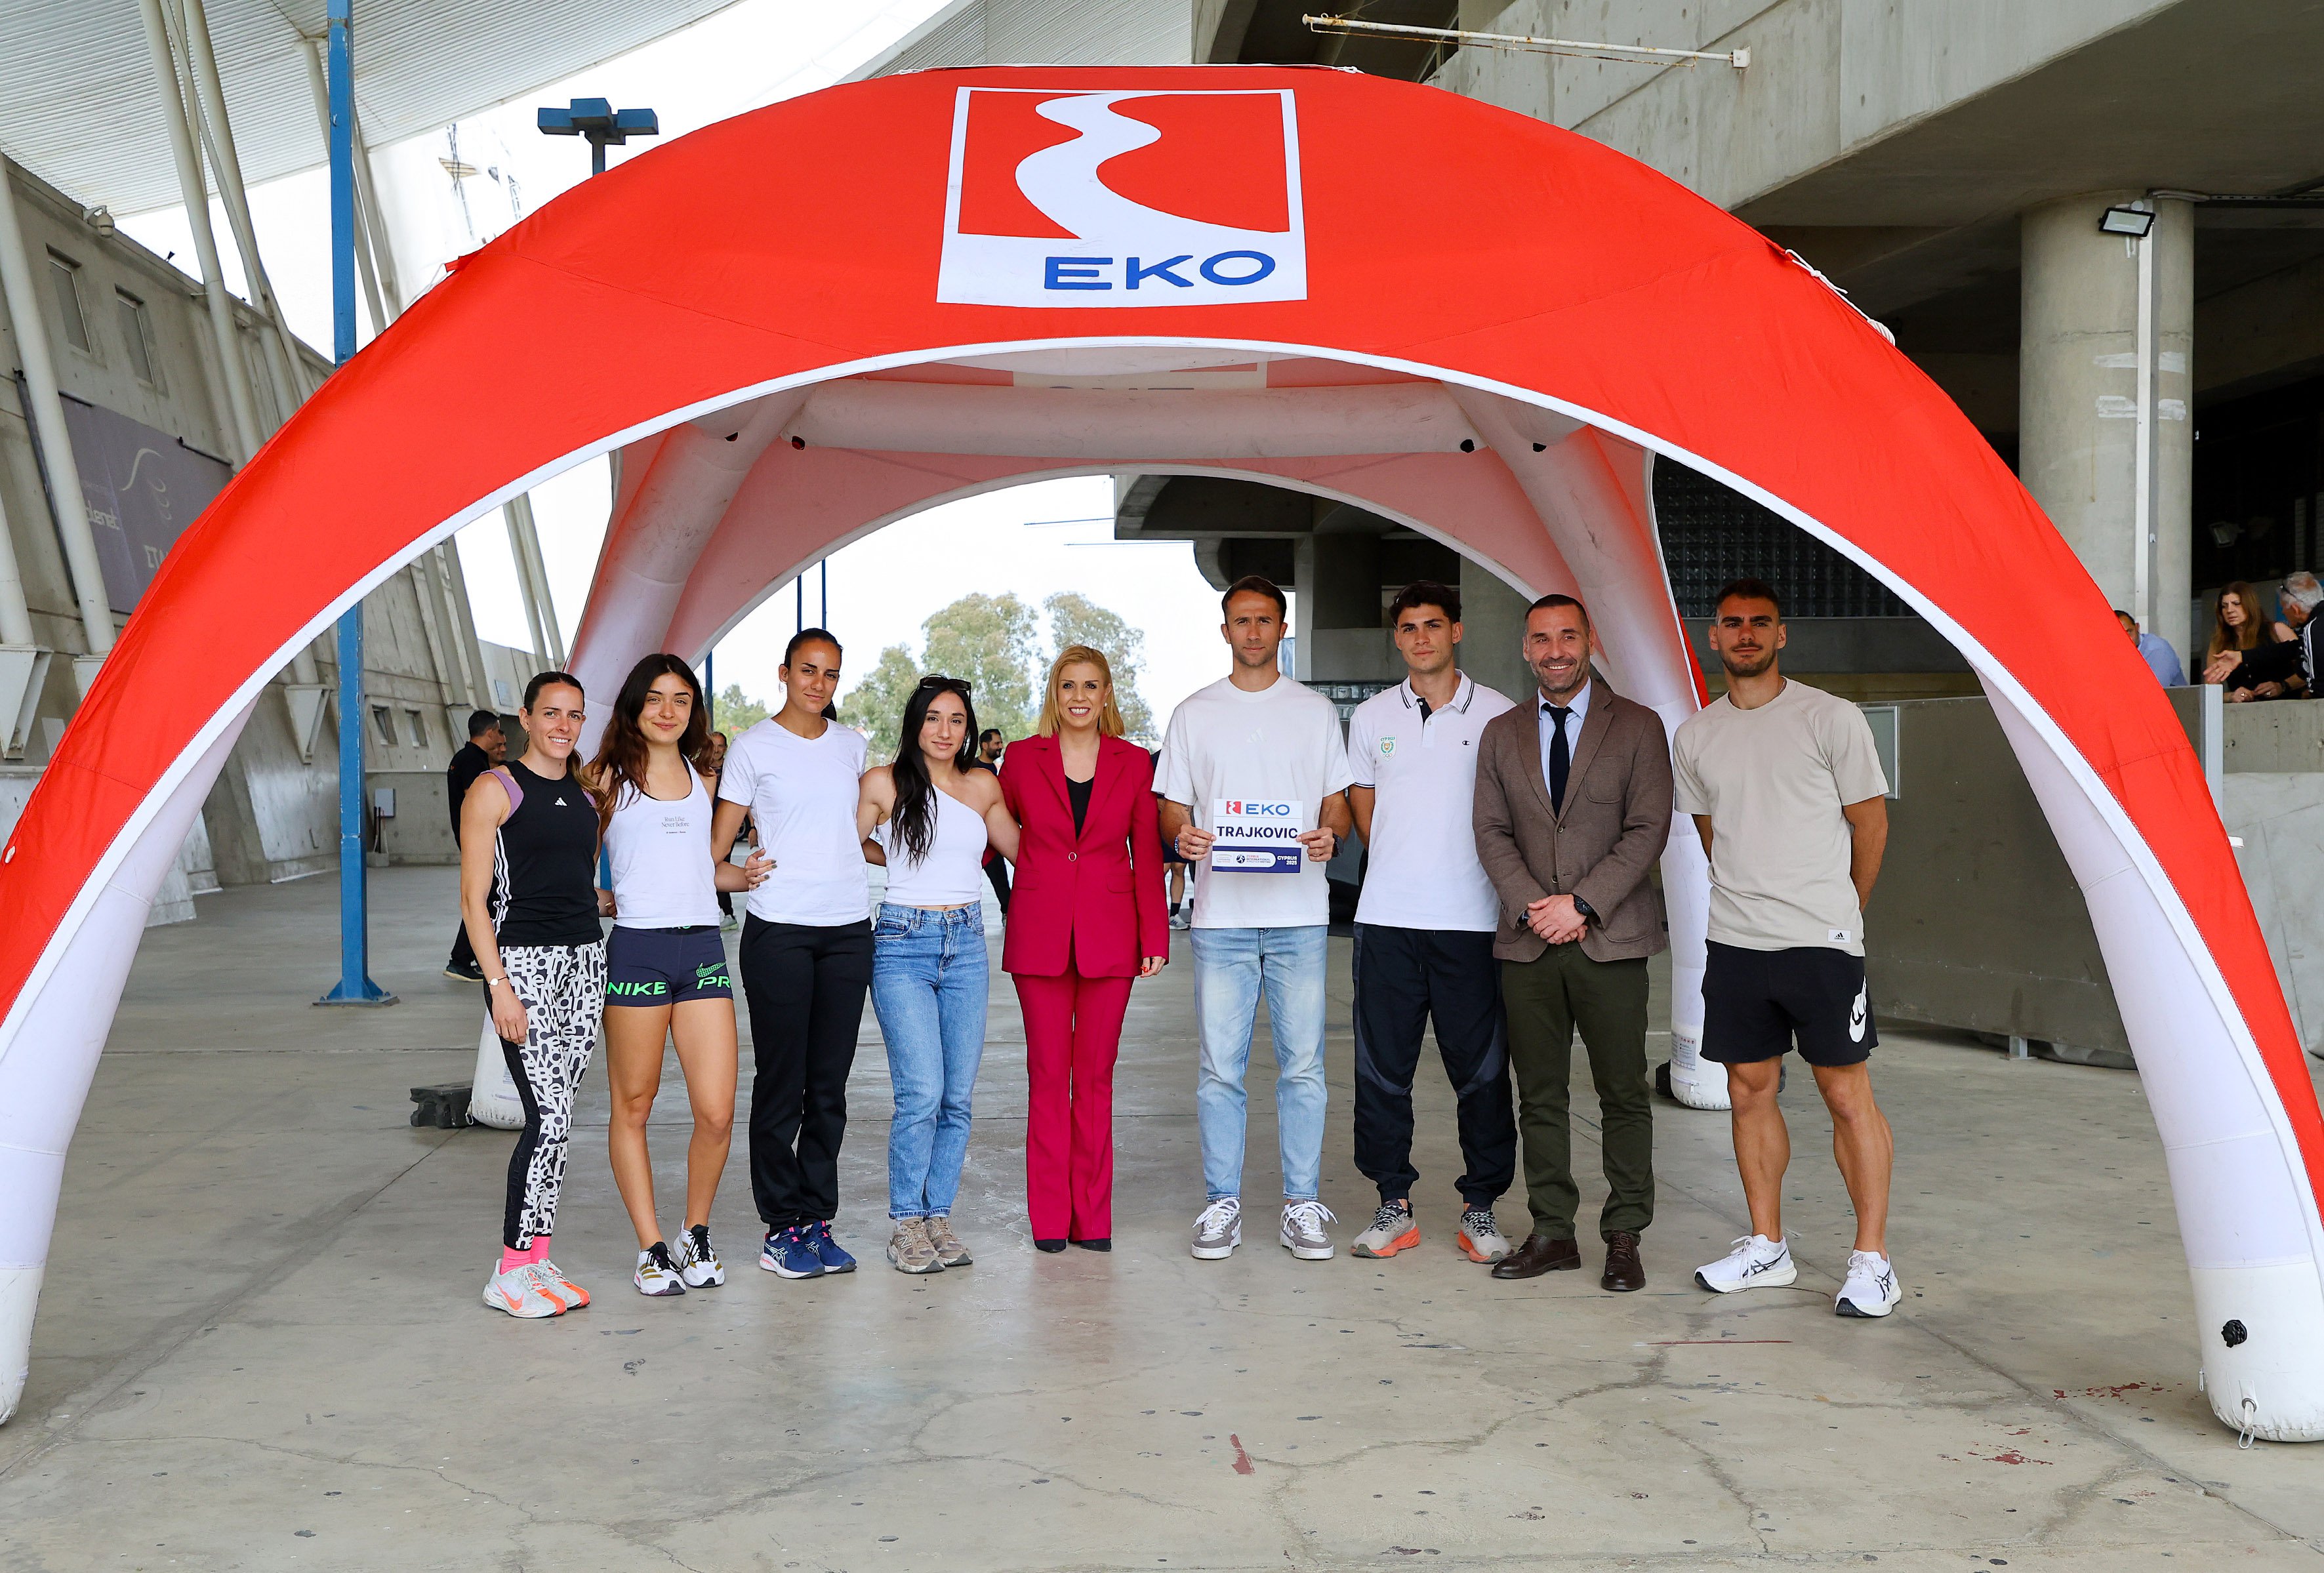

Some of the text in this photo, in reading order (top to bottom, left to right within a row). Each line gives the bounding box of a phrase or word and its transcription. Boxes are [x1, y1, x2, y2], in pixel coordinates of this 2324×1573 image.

[1044, 251, 1276, 290] EKO
[1246, 804, 1290, 815] EKO
[1217, 826, 1298, 838] TRAJKOVIC
[607, 981, 666, 996] NIKE
[697, 975, 731, 989] PR
